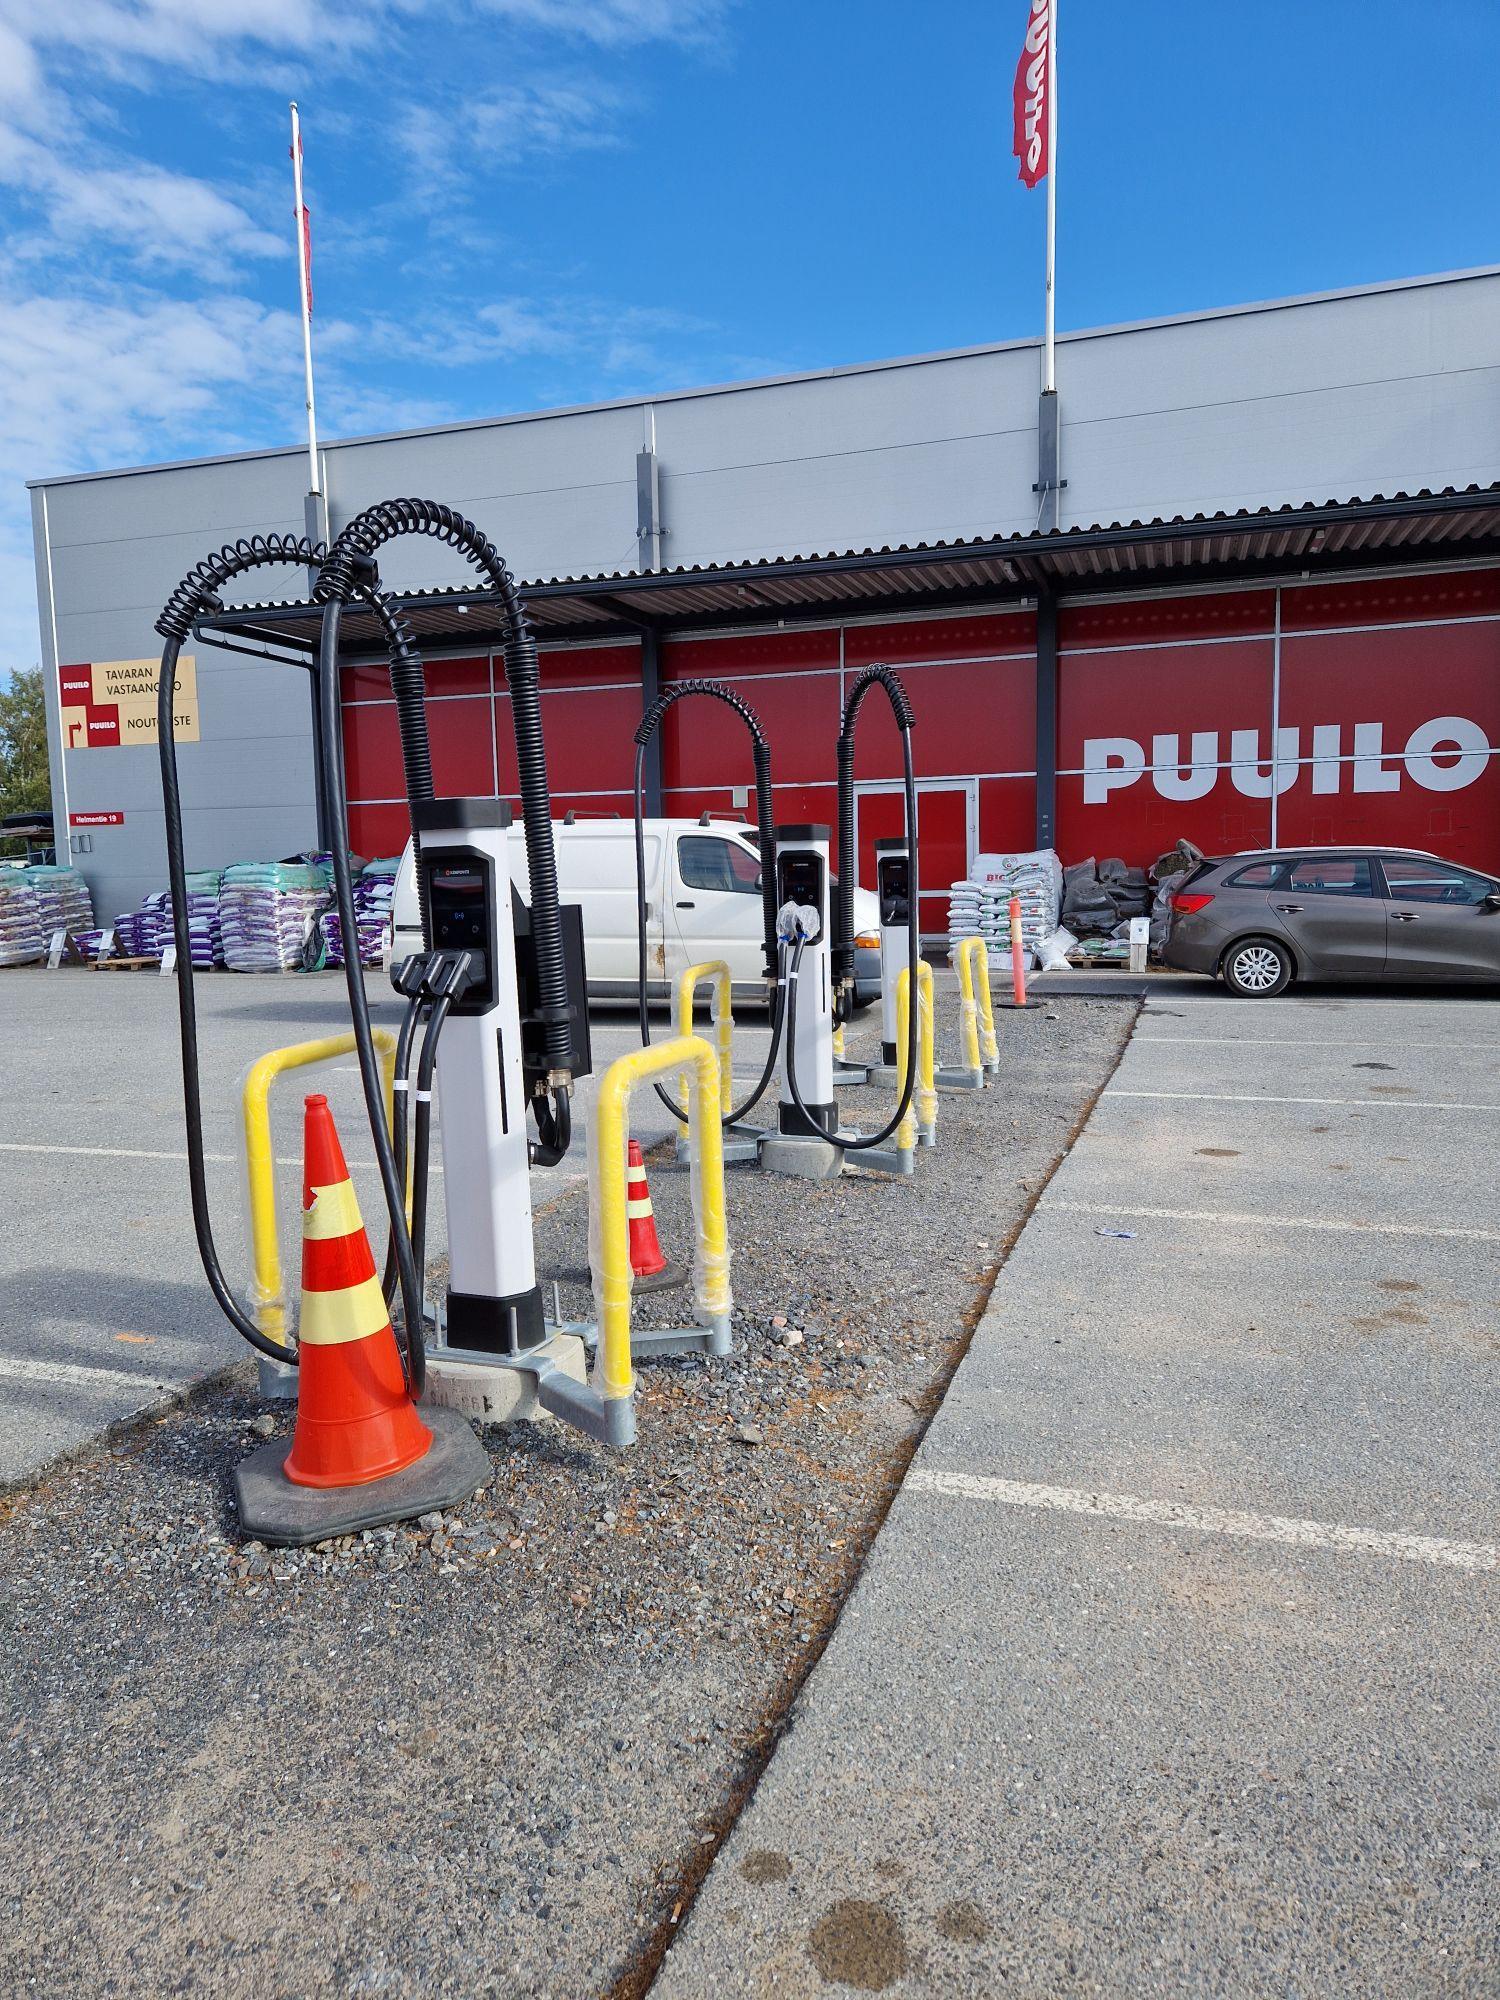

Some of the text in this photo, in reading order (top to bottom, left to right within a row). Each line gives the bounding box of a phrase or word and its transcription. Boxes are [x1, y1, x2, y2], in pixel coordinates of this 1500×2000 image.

[105, 667, 153, 680] TAVARAN
[63, 681, 90, 690] PUUILO
[106, 680, 182, 695] VASTAANOO
[89, 721, 117, 730] PUUILO
[127, 715, 191, 728] NOUTSTE
[1083, 716, 1490, 804] PUUILO
[108, 814, 117, 822] 19
